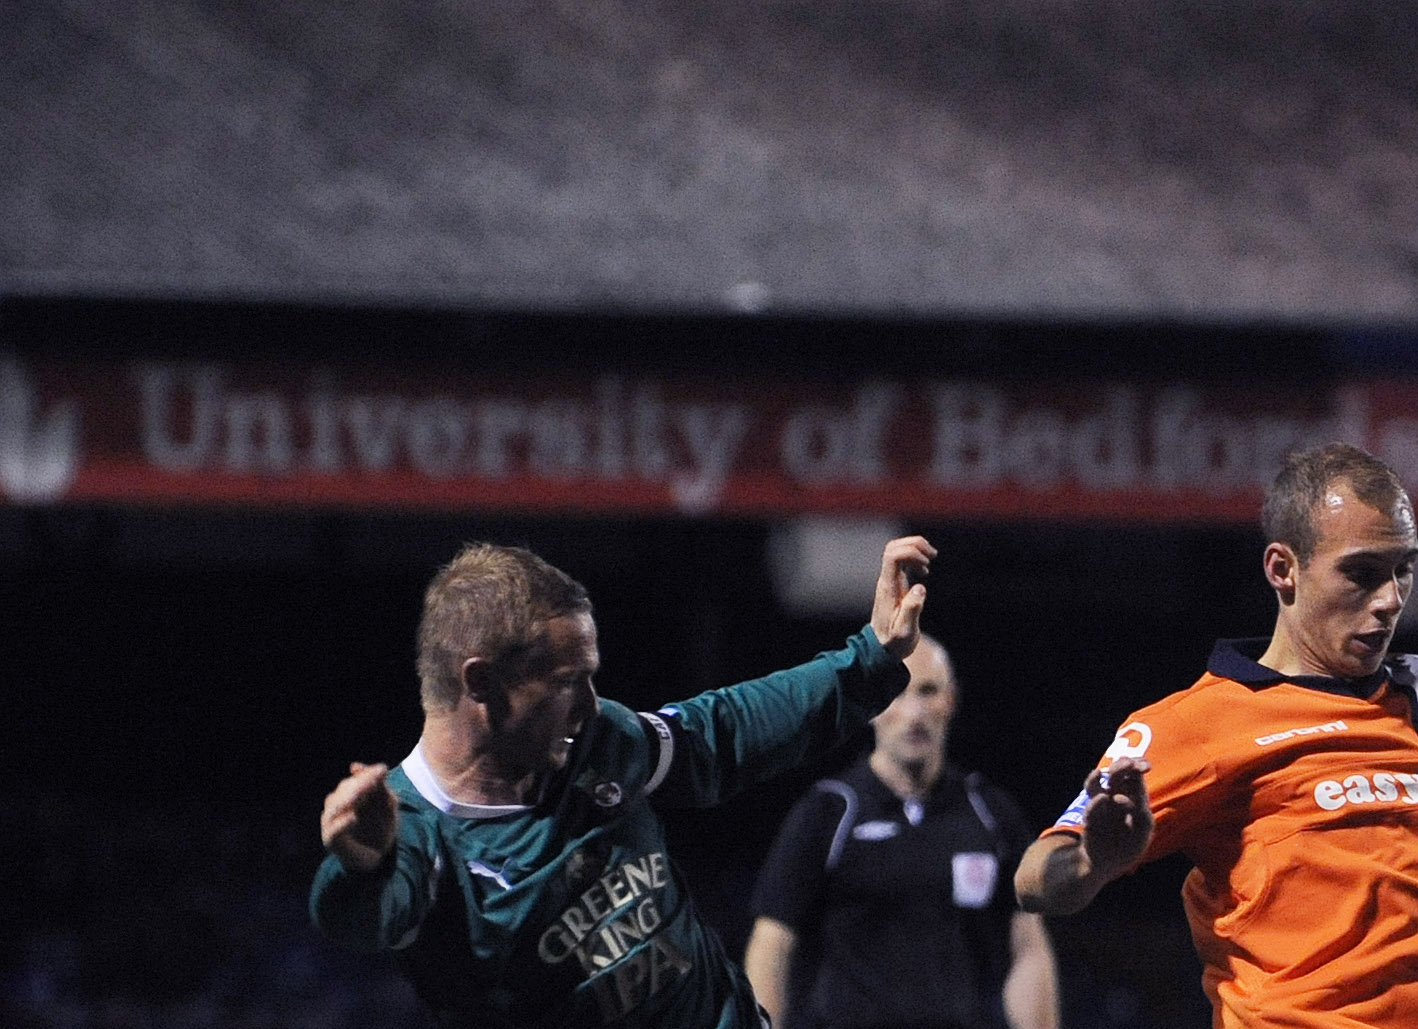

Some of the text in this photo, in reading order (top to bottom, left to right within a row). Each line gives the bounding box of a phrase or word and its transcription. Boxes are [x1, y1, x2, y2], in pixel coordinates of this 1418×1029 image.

[138, 362, 748, 514] University
[780, 380, 912, 484] of
[538, 853, 666, 963] GREENE
[575, 898, 661, 977] KING
